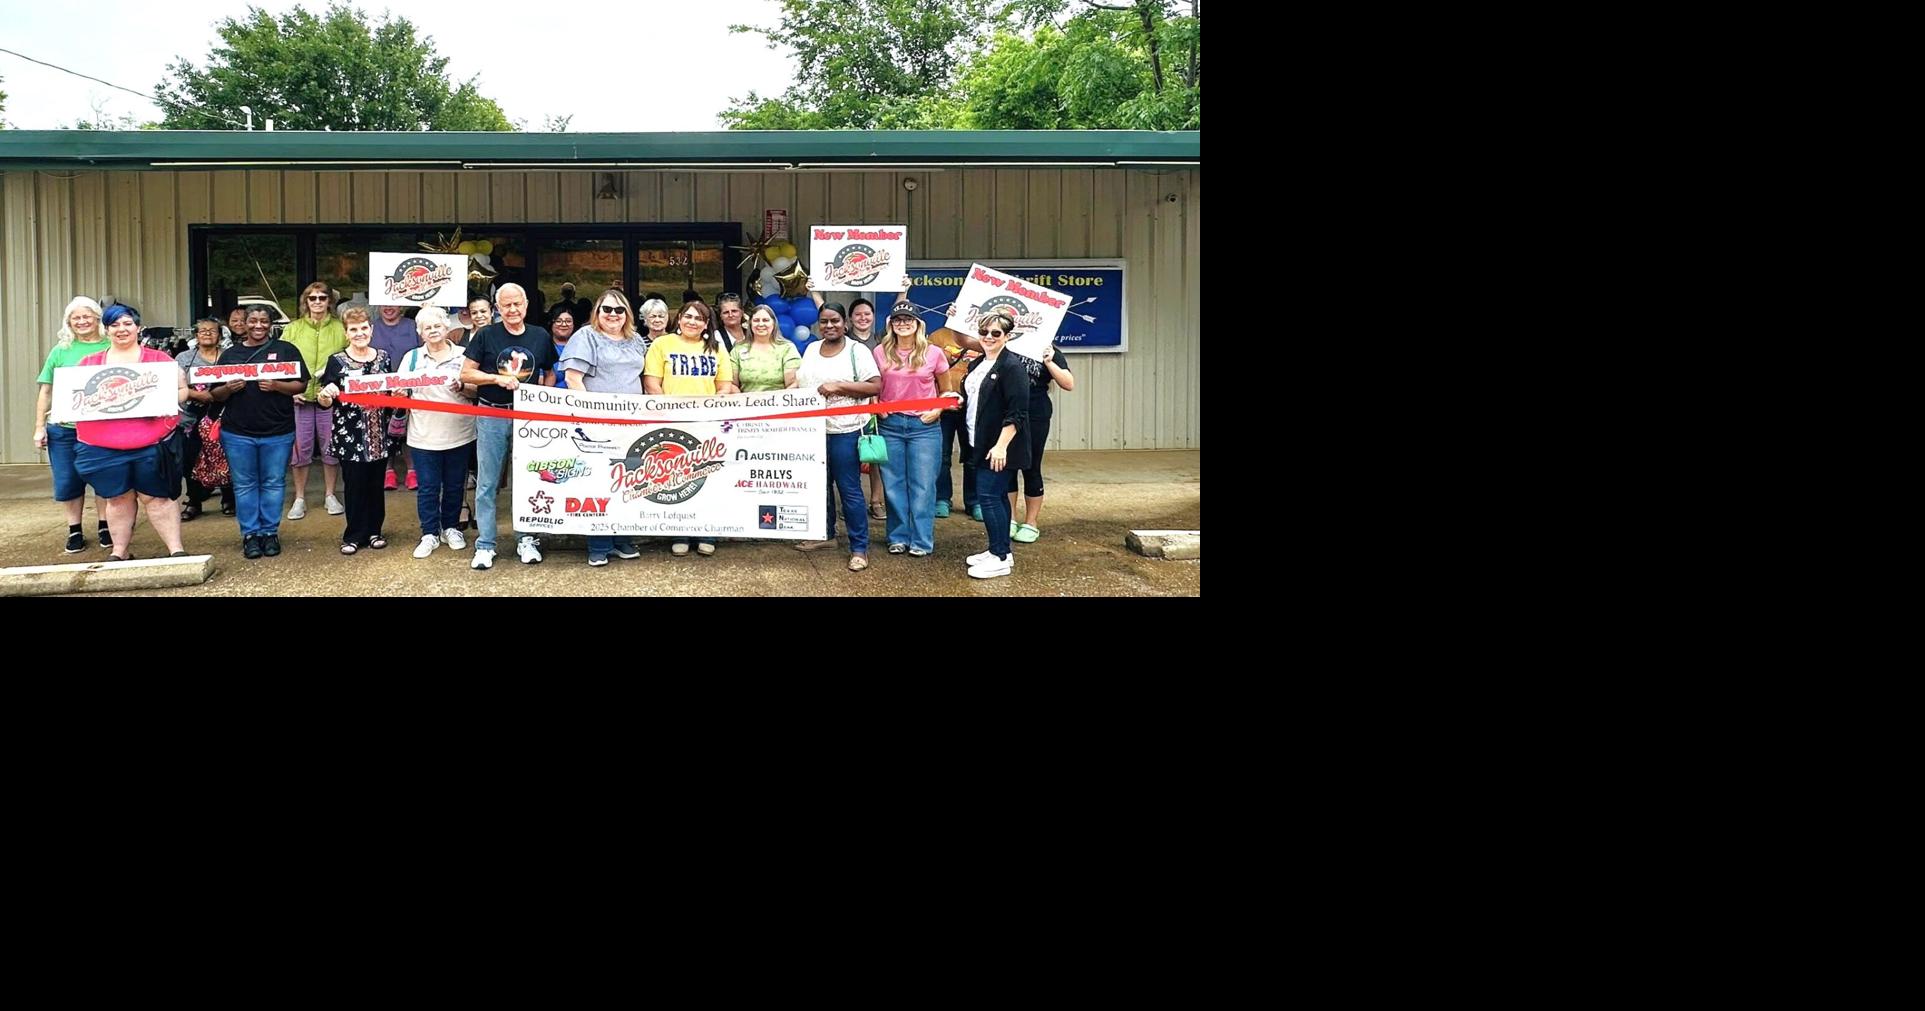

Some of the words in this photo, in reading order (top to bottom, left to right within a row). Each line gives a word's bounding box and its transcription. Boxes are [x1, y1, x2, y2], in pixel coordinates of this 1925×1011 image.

[814, 229, 845, 240] New
[847, 229, 902, 240] Member
[669, 256, 688, 266] 532
[825, 249, 890, 280] Jacksonville
[384, 264, 452, 295] Jacksonville
[1058, 274, 1103, 286] Store
[971, 267, 1005, 287] New
[1005, 279, 1066, 308] Member
[194, 364, 258, 379] Member
[261, 362, 296, 375] New
[348, 379, 383, 392] New
[385, 374, 448, 389] Member
[519, 389, 535, 402] Be
[538, 390, 562, 405] Our
[565, 394, 641, 415] Community.
[645, 399, 700, 411] Connect.
[703, 398, 741, 409] Grow.
[745, 396, 778, 407] Lead.
[782, 393, 820, 407] Share.
[518, 427, 568, 439] ONCOR
[527, 458, 577, 472] GIBSON
[610, 436, 727, 493] Jacksonville
[556, 466, 592, 479] SIGNS
[750, 469, 792, 480] BRALYS
[734, 479, 753, 488] ACE
[755, 480, 808, 490] HARDWARE
[656, 492, 678, 502] GROW
[679, 482, 698, 498] HERE!
[565, 497, 611, 513] DAY
[519, 516, 564, 525] REPUBLIC
[610, 522, 647, 532] Chamber
[649, 523, 658, 532] of
